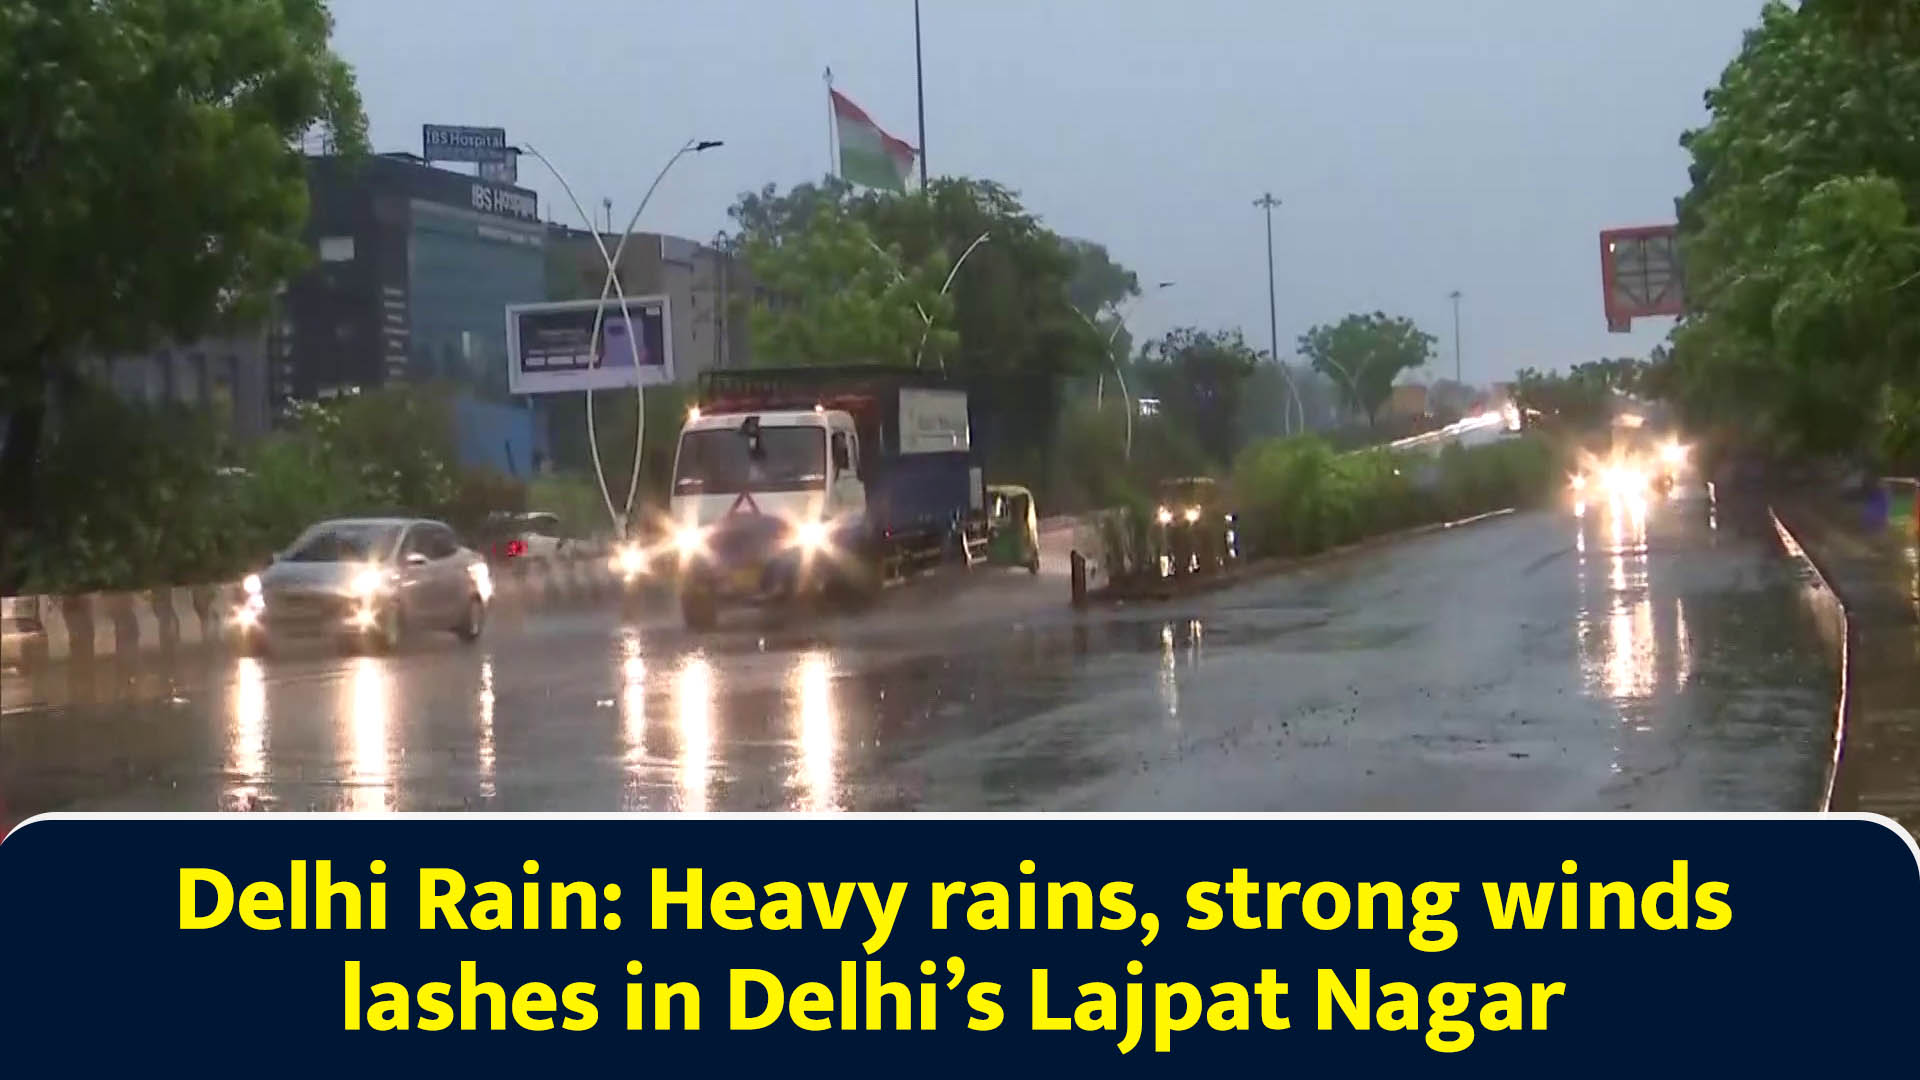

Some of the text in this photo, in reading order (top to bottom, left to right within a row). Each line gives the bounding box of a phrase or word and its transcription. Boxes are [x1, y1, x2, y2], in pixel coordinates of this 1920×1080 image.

[426, 130, 503, 149] IBS Hospital
[472, 183, 536, 220] IBS Hosp
